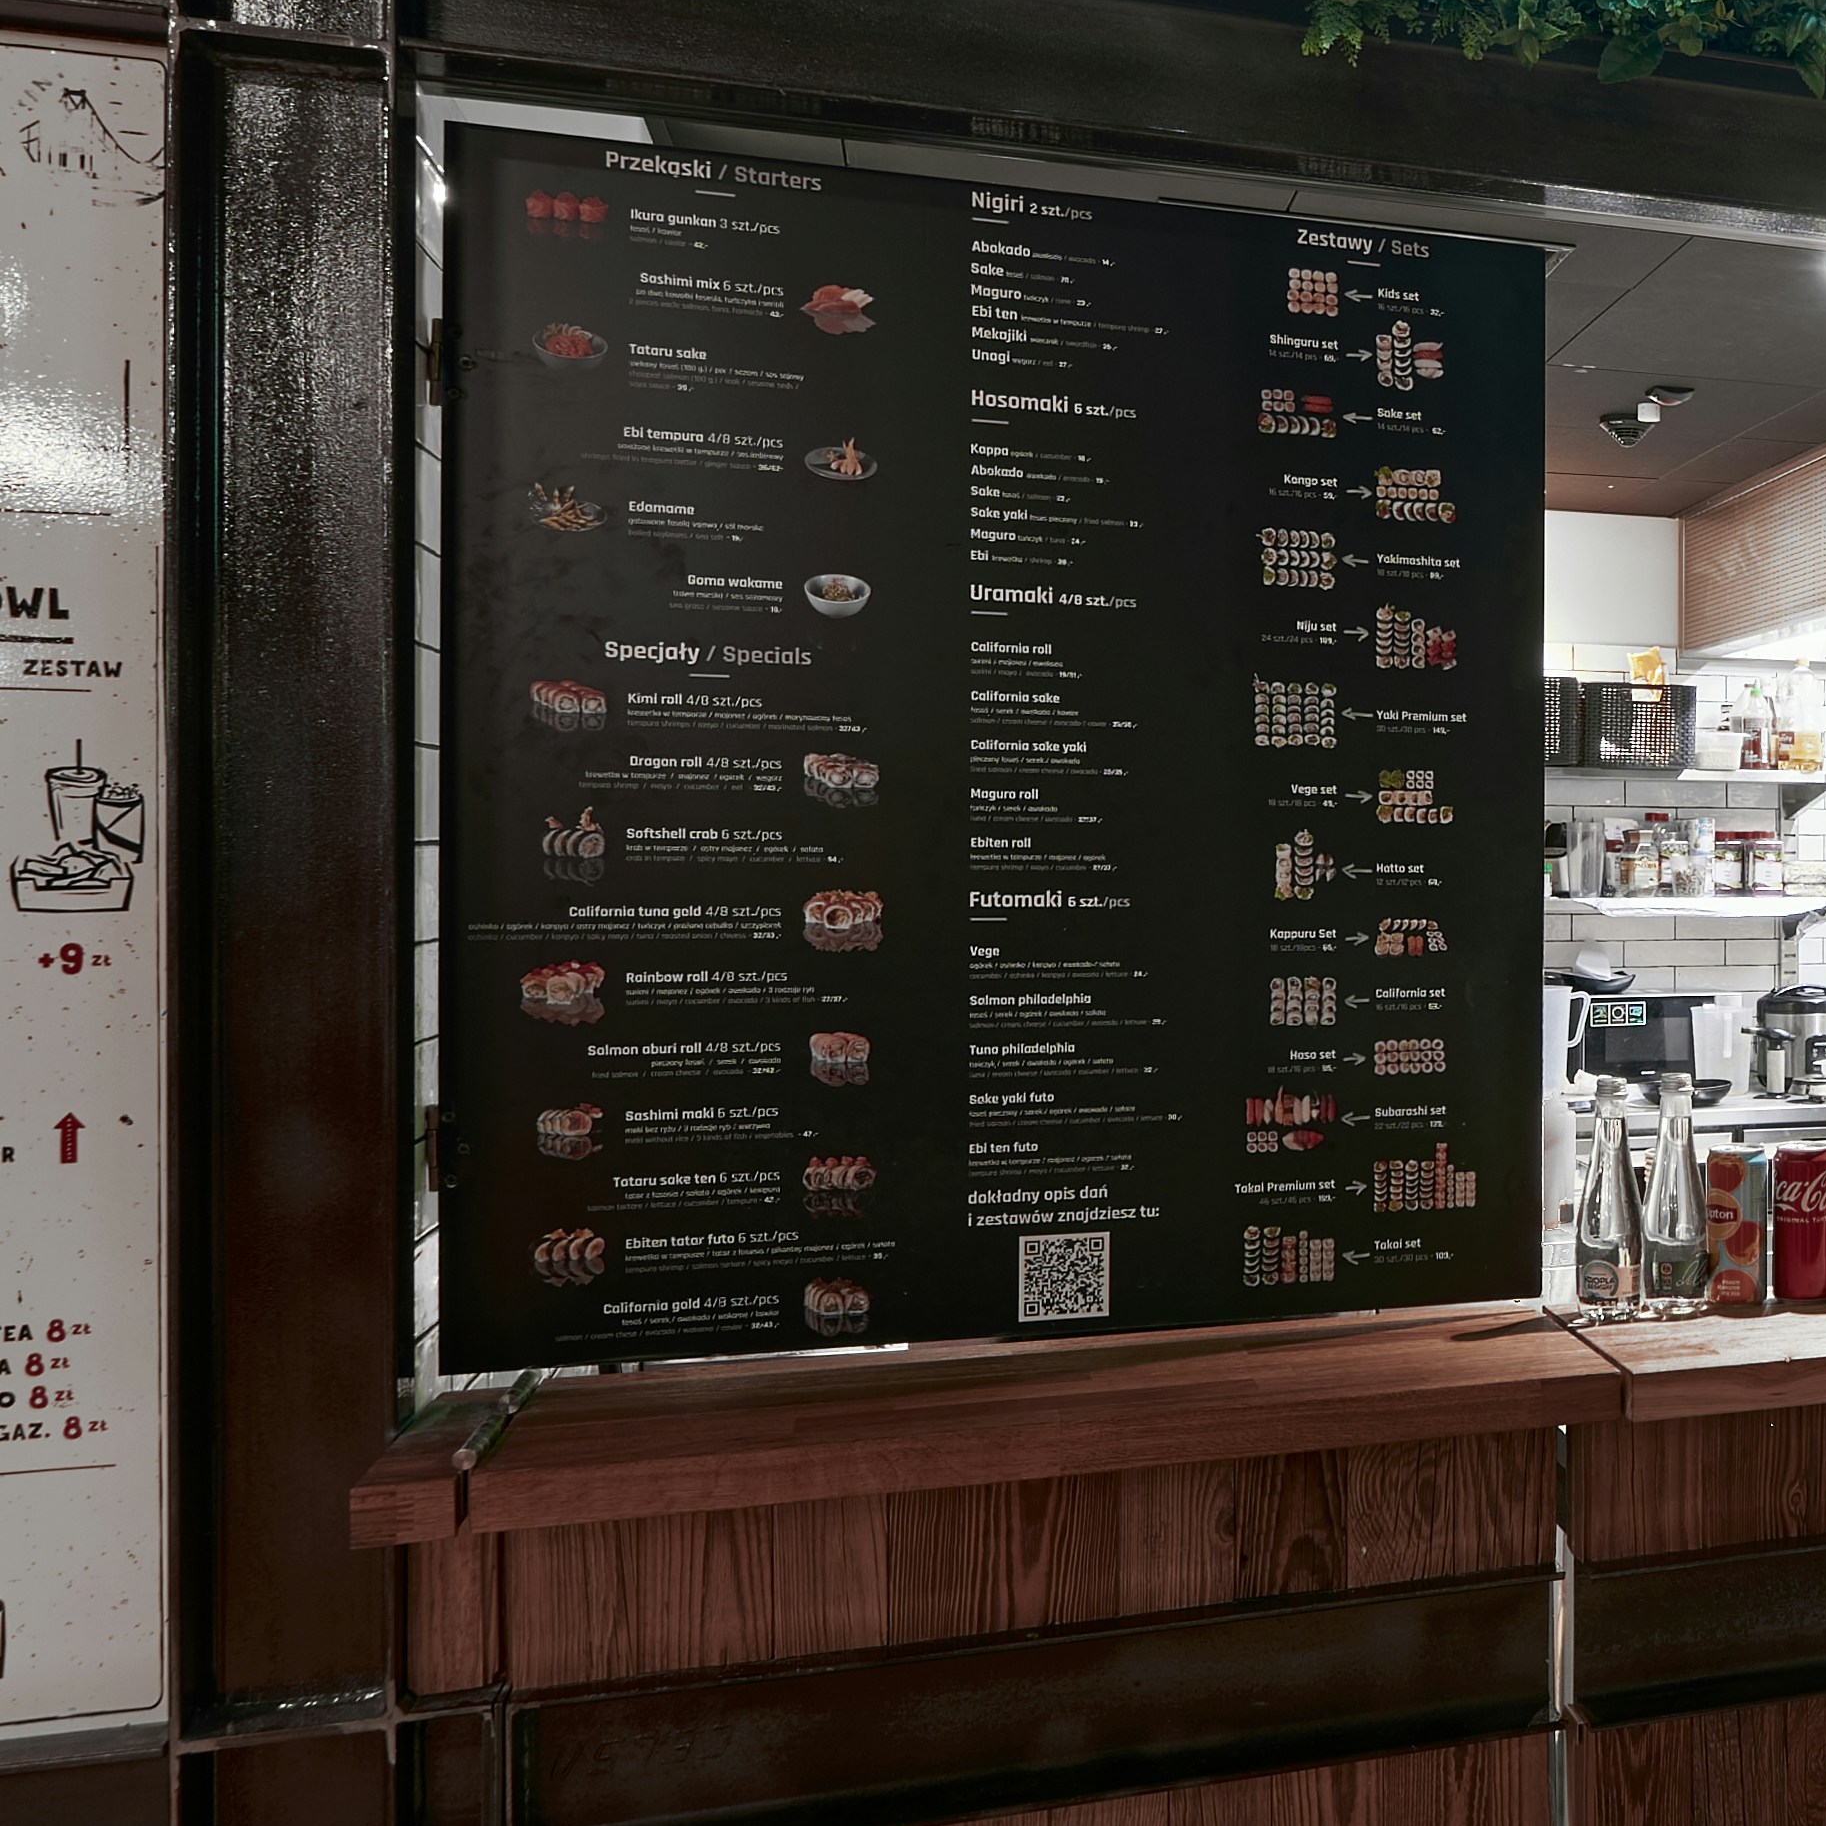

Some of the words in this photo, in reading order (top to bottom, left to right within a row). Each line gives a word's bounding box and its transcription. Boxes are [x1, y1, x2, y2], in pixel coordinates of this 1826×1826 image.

[605, 150, 712, 180] Przekąski
[734, 165, 822, 192] Starters
[971, 190, 1024, 215] Nigiri
[1029, 201, 1038, 216] 2
[1040, 204, 1093, 221] szt./pcs
[630, 207, 665, 223] Ikura
[667, 213, 717, 229] gunkan
[719, 218, 728, 230] 3
[970, 239, 1032, 259] Abokado
[1297, 228, 1373, 256] Zestawy
[1391, 239, 1430, 259] Sets
[639, 271, 693, 288] Sashimi
[696, 277, 721, 292] mix
[723, 279, 732, 292] 6
[734, 282, 784, 298] szt./pcs
[970, 283, 1023, 301] Maguro
[1377, 287, 1401, 301] Kids
[1402, 291, 1420, 303] set
[628, 343, 673, 358] Tataru
[675, 347, 707, 361] sake
[971, 388, 1069, 414] Hosomaki
[1074, 402, 1083, 416] 6
[1085, 404, 1137, 419] szt./pcs
[1377, 407, 1404, 420] Sake
[1405, 410, 1422, 422] set
[623, 425, 644, 439] Ebi
[646, 427, 704, 444] tempura
[734, 435, 784, 450] szt./pcs
[969, 442, 1010, 459] Kappa
[969, 464, 1025, 480] Abokado
[628, 499, 695, 516] Edamame
[1376, 552, 1442, 568] Yakimashita
[1443, 557, 1461, 569] set
[687, 574, 725, 587] Goma
[727, 575, 783, 590] wakame
[970, 583, 1053, 605] Uramaki
[1058, 592, 1083, 607] 4/8
[1085, 594, 1137, 609] szt./pcs
[604, 640, 700, 666] Specjały
[723, 645, 812, 666] Specials
[970, 640, 1030, 655] California
[1032, 642, 1052, 655] roll
[23, 659, 122, 677] ZESTAW
[627, 691, 658, 705] Kimi
[660, 692, 683, 706] roll
[712, 695, 763, 709] szt./pcs
[970, 689, 1030, 703] California
[1031, 691, 1060, 704] sake
[1376, 709, 1399, 721] Yaki
[1401, 710, 1449, 722] Premium
[1450, 711, 1467, 723] set
[629, 755, 678, 770] Dragon
[680, 754, 703, 769] roll
[706, 756, 729, 769] 4/8
[970, 787, 1016, 802] Maguro
[1018, 787, 1039, 800] roll
[1290, 783, 1318, 797] Vege
[1320, 784, 1338, 795] set
[969, 889, 1062, 908] Futomaki
[1067, 896, 1077, 908] 6
[1078, 896, 1131, 910] szt./pcs
[568, 905, 635, 917] California
[637, 906, 670, 917] tuna
[672, 905, 702, 920] gold
[705, 905, 729, 917] 4/8
[1269, 927, 1317, 941] Kappuru
[1318, 928, 1337, 940] Set
[92, 955, 112, 966] zł
[969, 945, 1000, 959] Vege
[625, 970, 684, 984] Rainbow
[686, 969, 709, 983] roll
[711, 970, 735, 983] 4/8
[969, 993, 1016, 1006] Salmon
[1018, 992, 1092, 1007] philadelphia
[1375, 986, 1427, 999] California
[1428, 987, 1446, 999] set
[967, 1187, 1040, 1206] dokładny
[1043, 1185, 1076, 1204] opis
[1079, 1184, 1108, 1200] dań
[967, 1211, 973, 1227] i
[976, 1208, 1054, 1227] zestawów
[1057, 1205, 1137, 1225] znajdziesz
[1139, 1204, 1160, 1219] tu:
[1373, 1238, 1403, 1251] Takai
[1404, 1237, 1421, 1250] set
[47, 1319, 66, 1343] 8
[72, 1323, 92, 1335] zł
[25, 1353, 44, 1376] 8
[50, 1357, 70, 1369] zł
[29, 1386, 48, 1409] 8
[55, 1389, 75, 1402] zł
[64, 1416, 82, 1440] 8
[88, 1420, 109, 1432] zł
